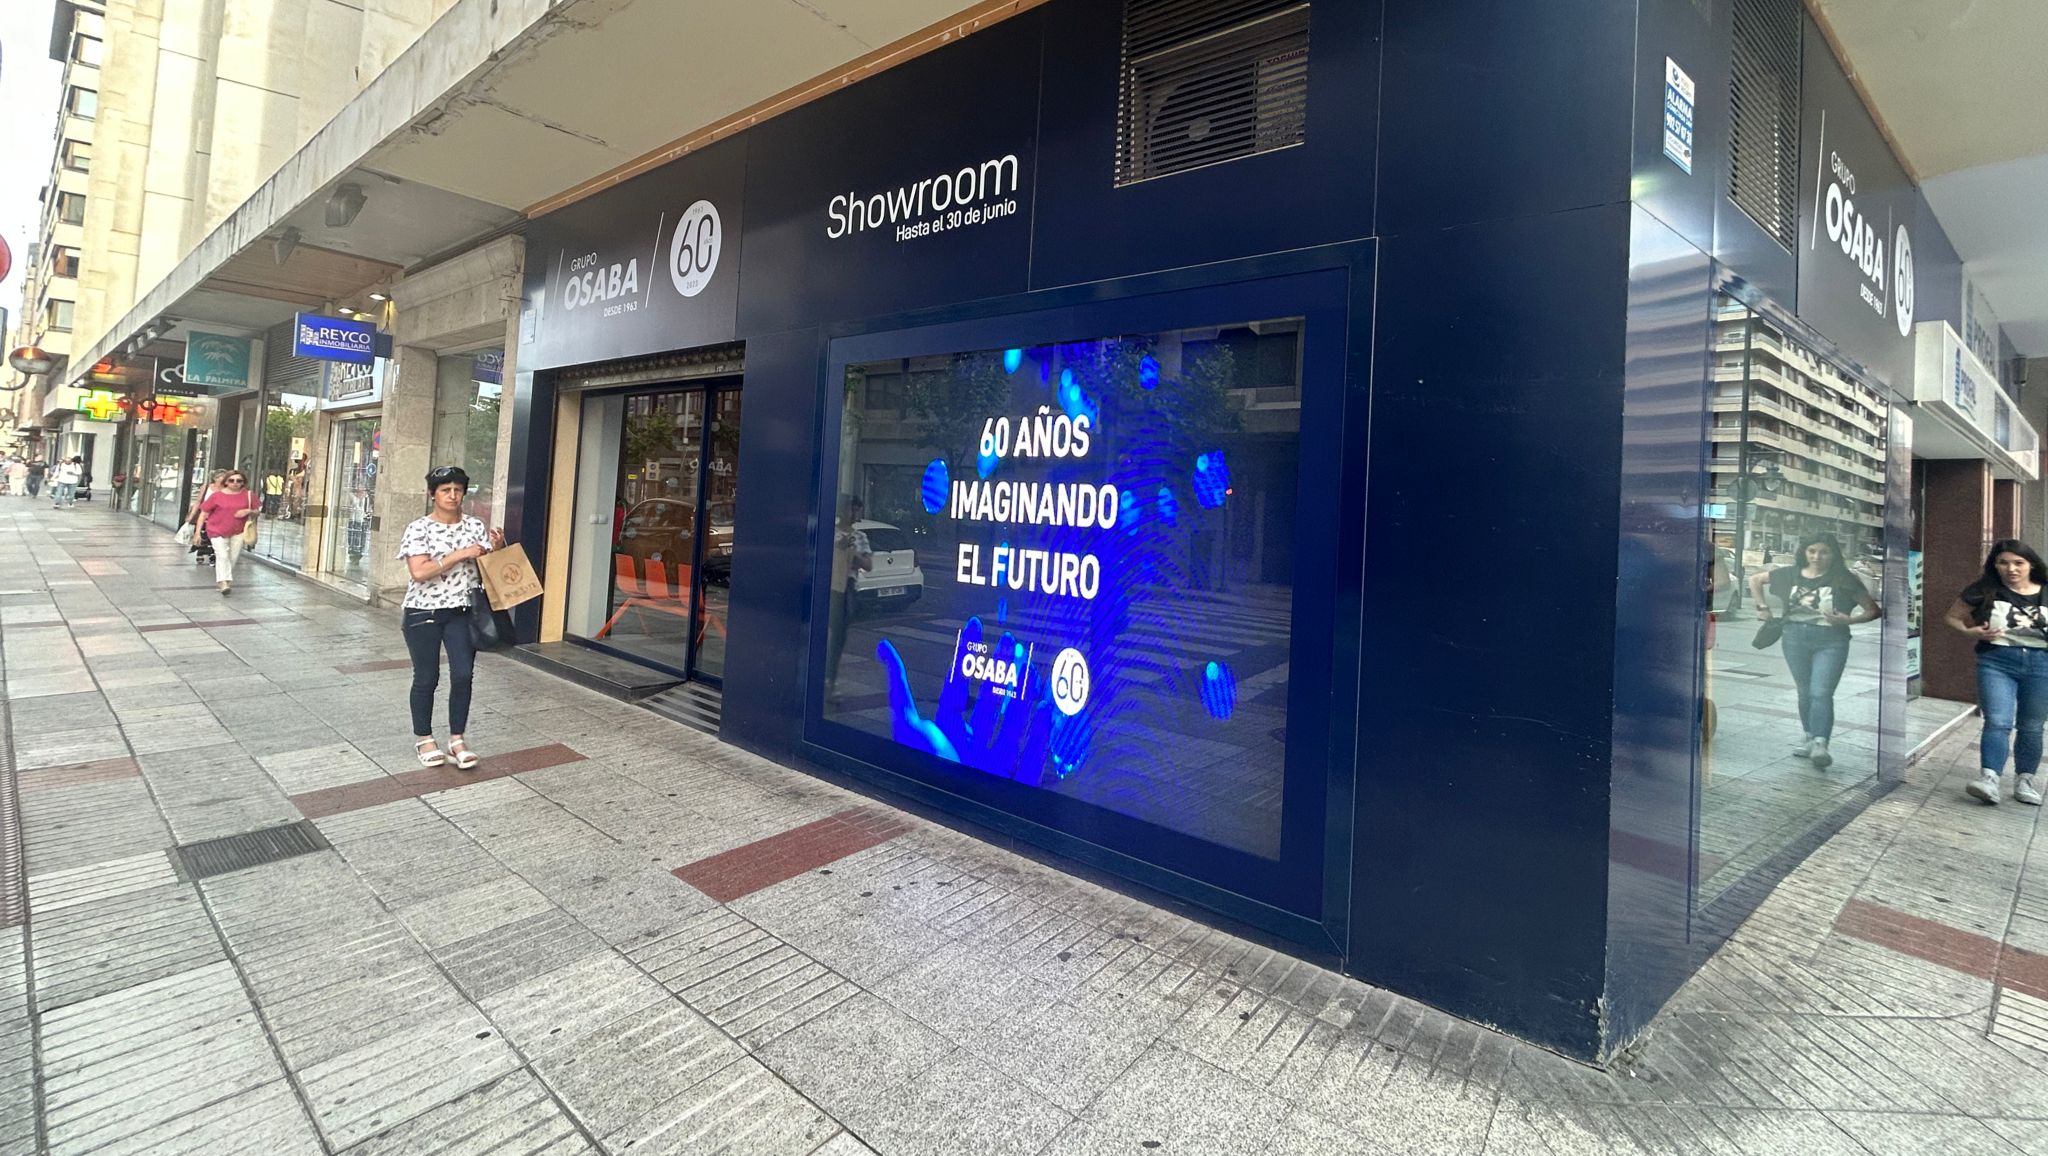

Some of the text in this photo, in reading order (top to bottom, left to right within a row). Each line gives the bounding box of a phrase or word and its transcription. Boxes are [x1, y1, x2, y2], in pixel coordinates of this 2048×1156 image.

[1831, 150, 1855, 195] GRUPO
[826, 154, 1018, 239] Showroom
[896, 198, 1016, 242] Hasta el 30 de junio
[1825, 182, 1883, 291] OSABA
[571, 252, 597, 272] GRUPO
[677, 213, 714, 278] 60
[564, 258, 638, 311] OSABA
[603, 301, 638, 317] DESDE 1963
[320, 327, 371, 344] REYCO
[320, 339, 371, 350] INMOBILIARIA
[187, 374, 200, 382] LA
[979, 405, 1090, 458] 60 AÑOS
[950, 480, 1118, 529] IMAGINANDO
[957, 543, 1101, 600] EL FUTURO
[967, 641, 988, 654] GRUPO
[962, 653, 1017, 687] OSABA
[1056, 659, 1084, 703] 60
